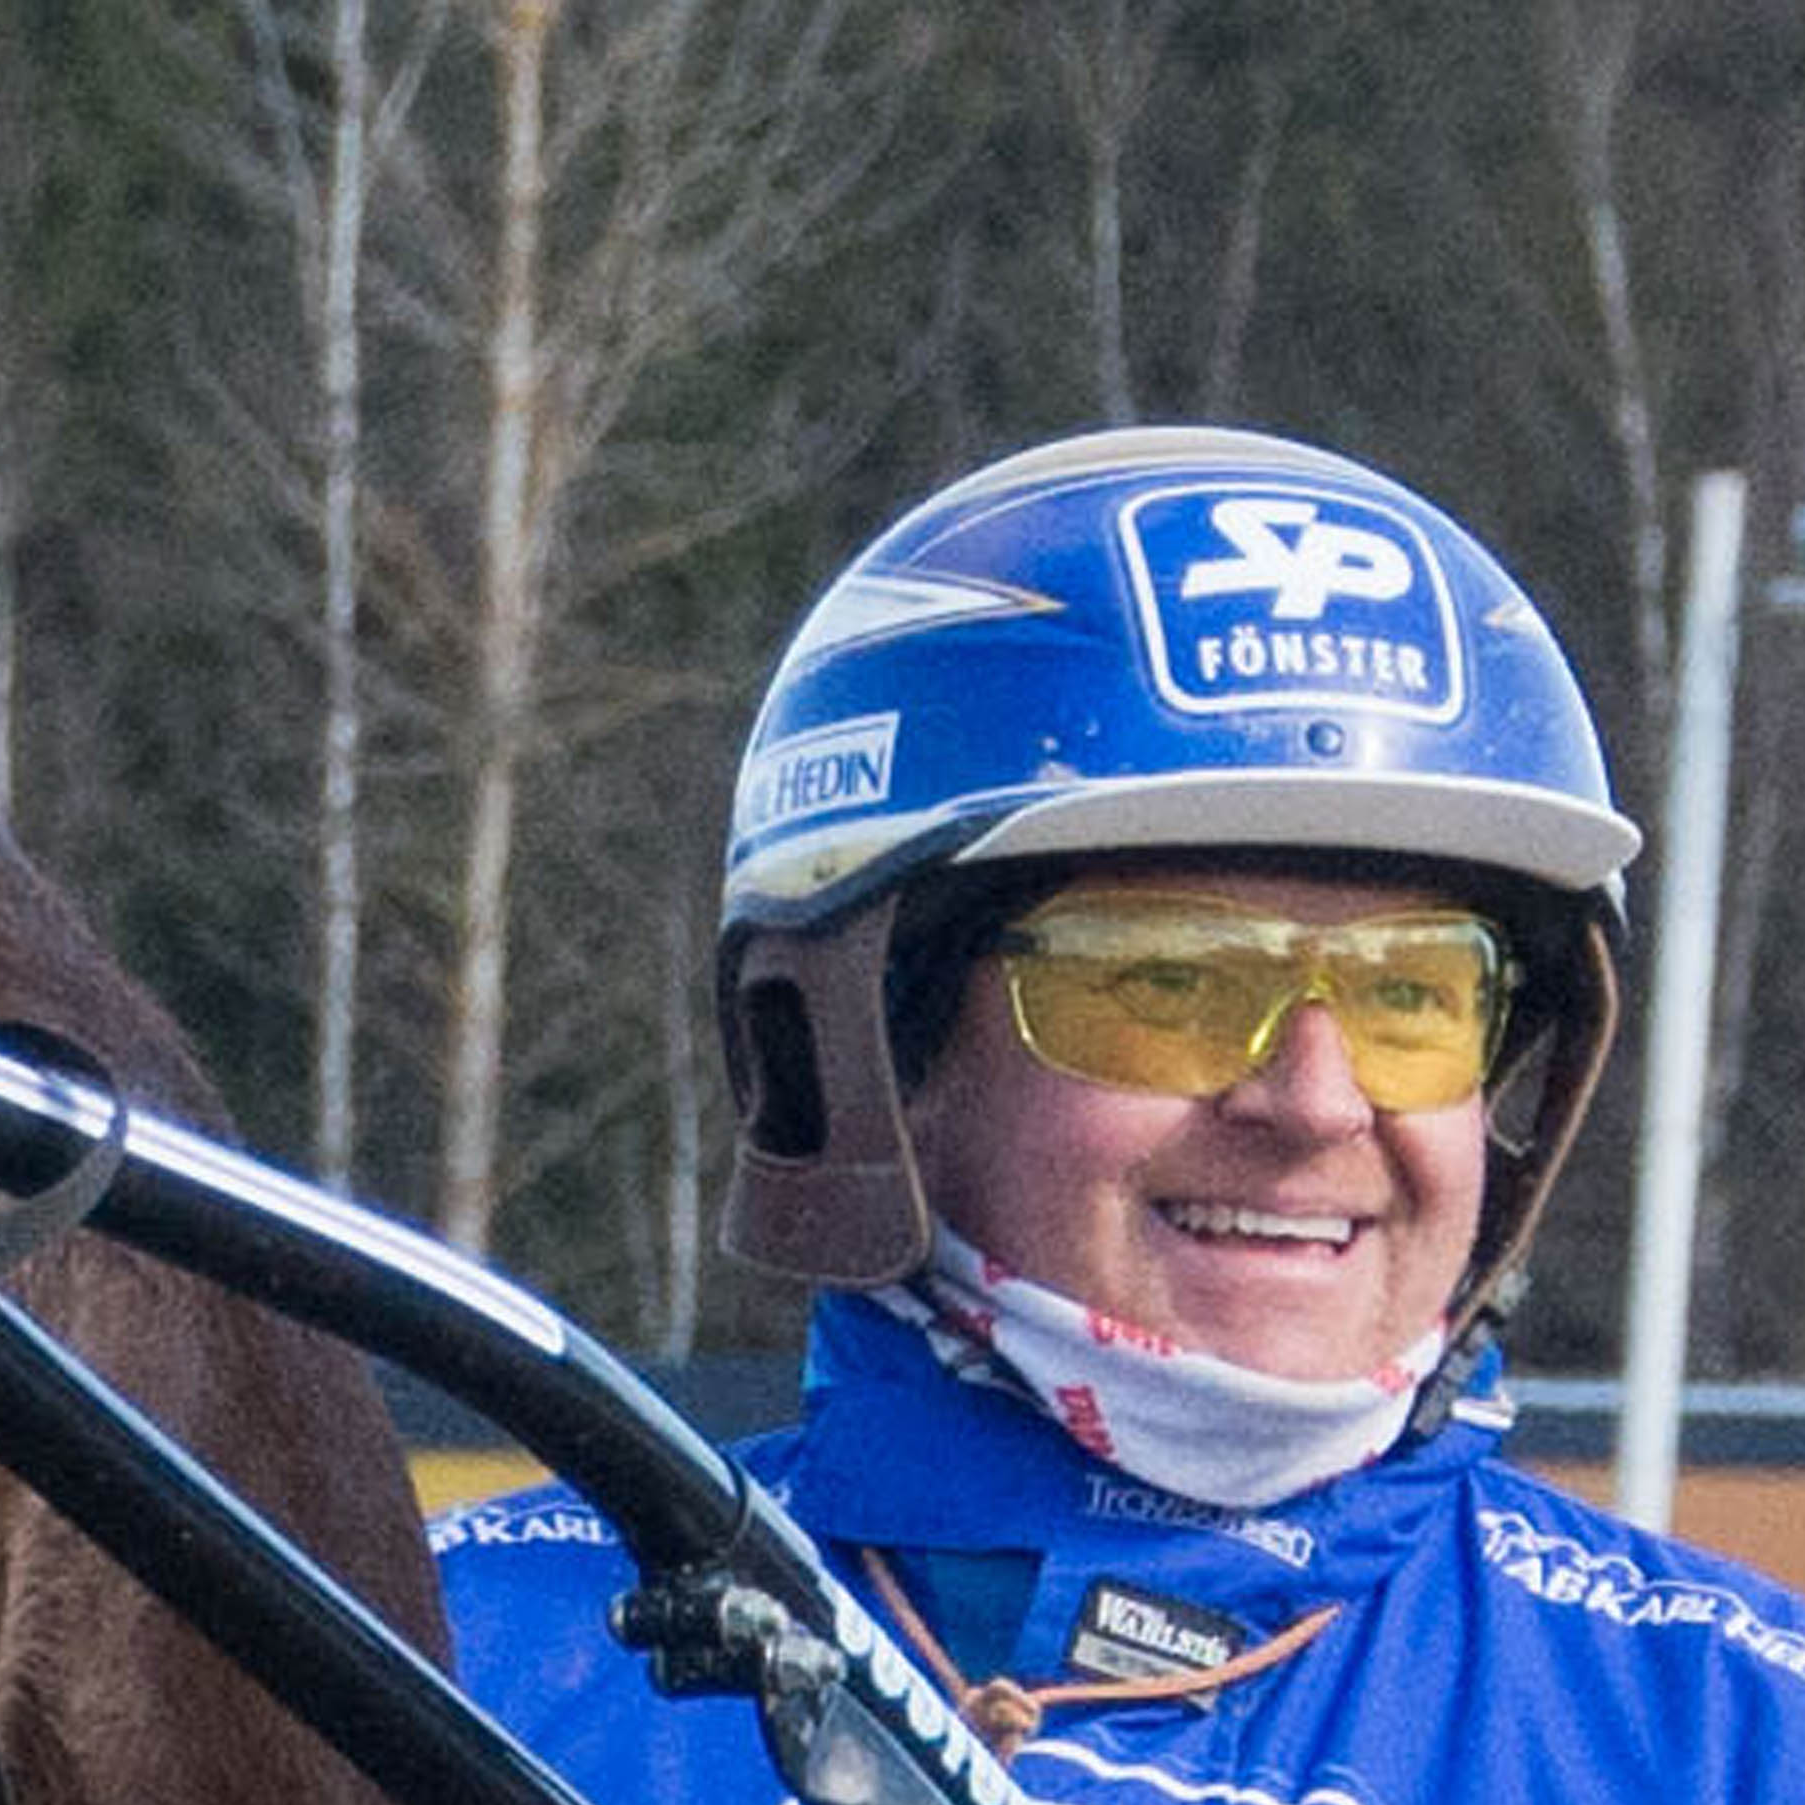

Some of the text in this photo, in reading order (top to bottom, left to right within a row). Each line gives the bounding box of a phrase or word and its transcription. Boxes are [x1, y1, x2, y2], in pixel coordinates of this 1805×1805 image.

[1179, 498, 1413, 621] SP
[1196, 626, 1429, 690] FÖNSTER
[773, 742, 887, 815] HEDIN
